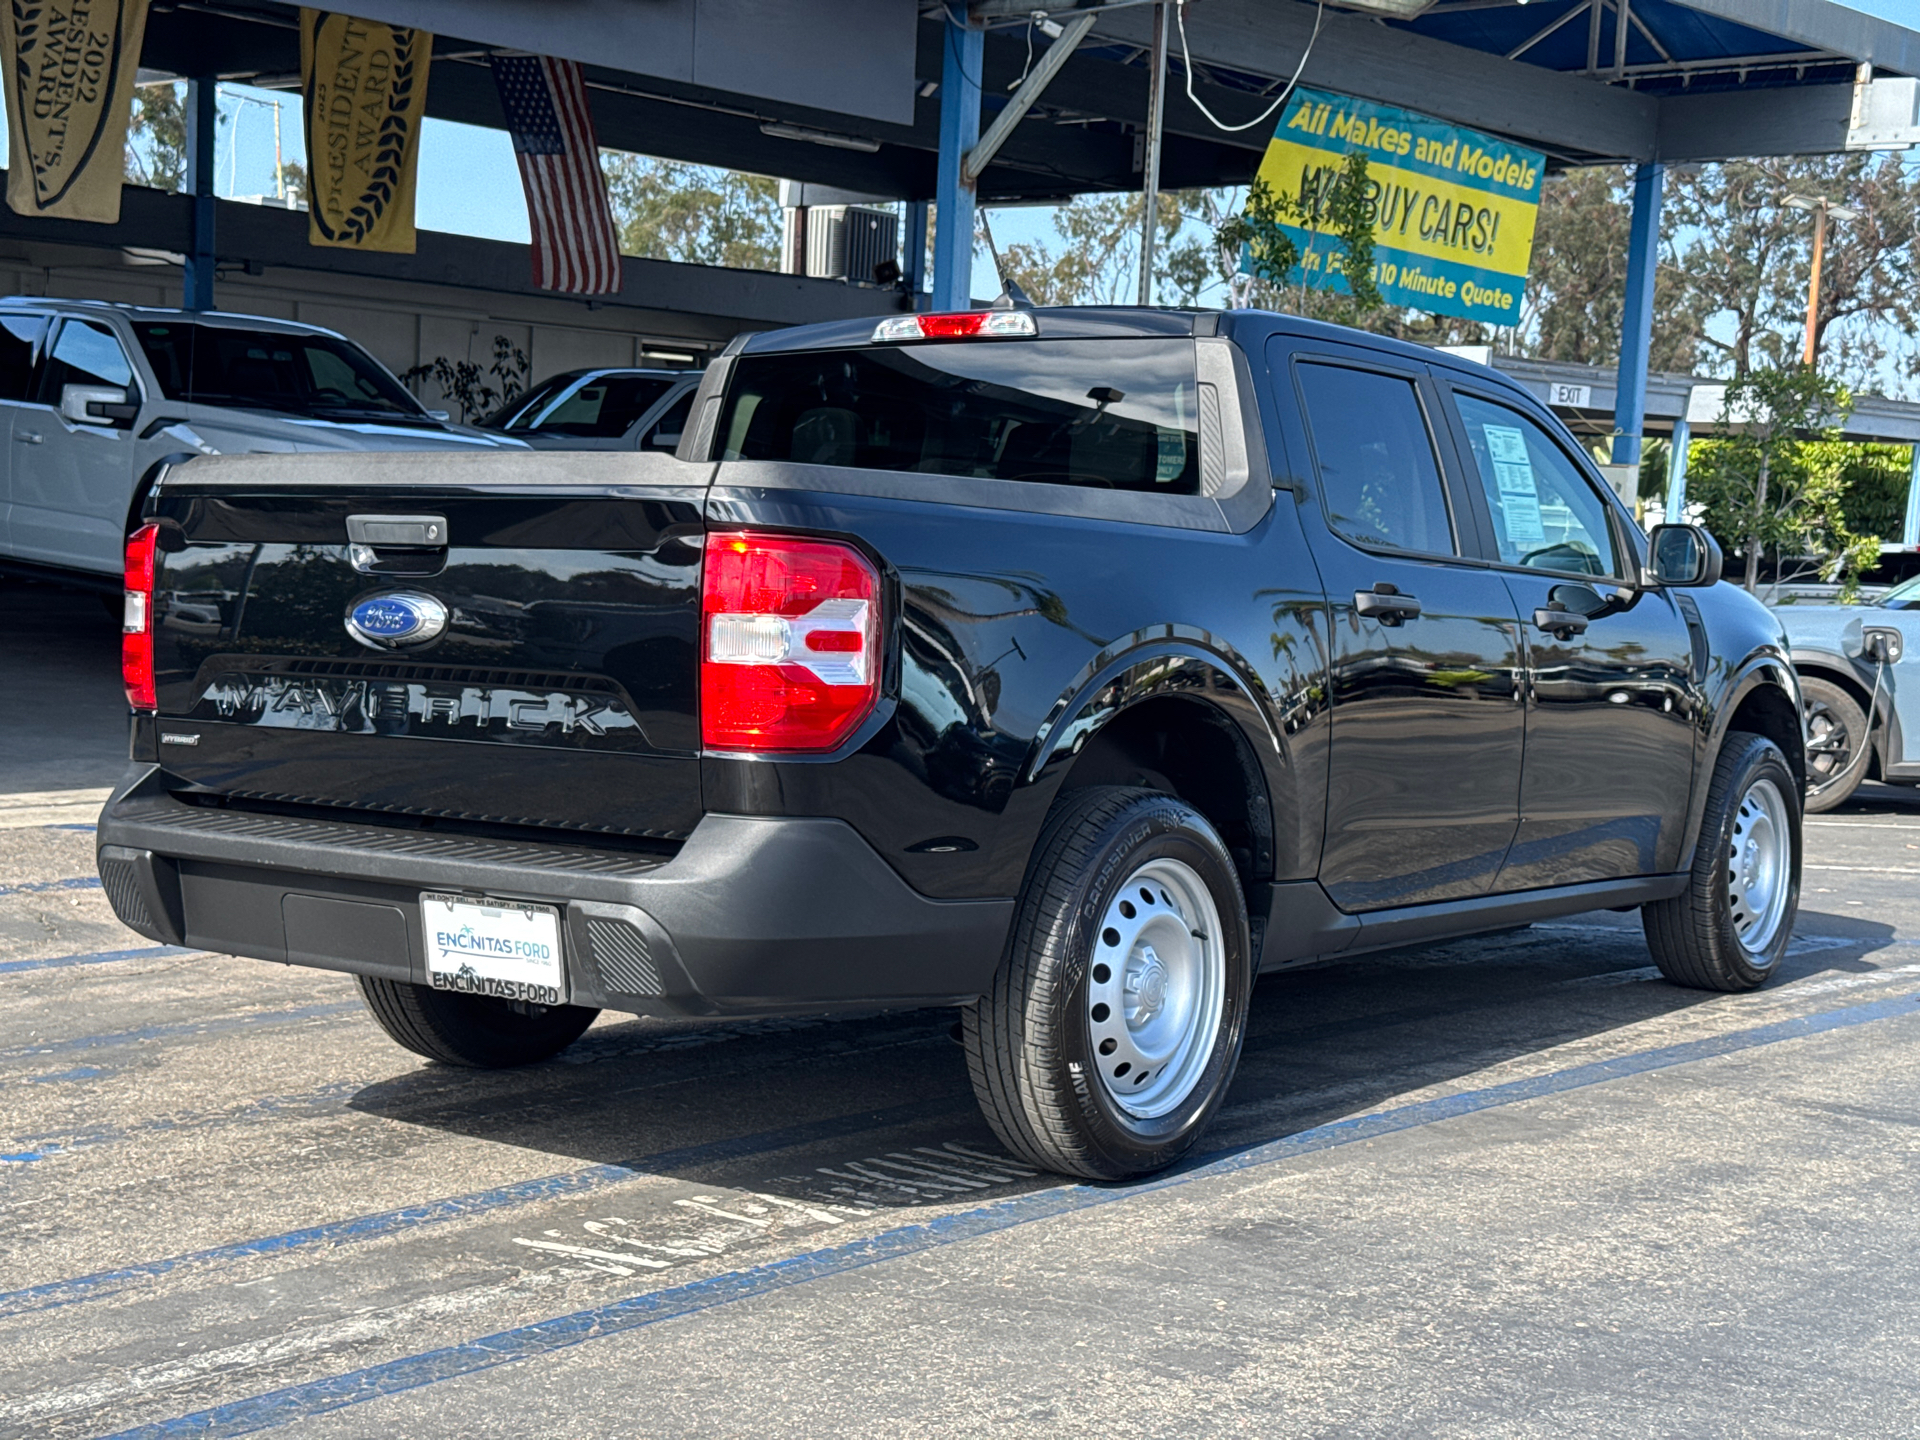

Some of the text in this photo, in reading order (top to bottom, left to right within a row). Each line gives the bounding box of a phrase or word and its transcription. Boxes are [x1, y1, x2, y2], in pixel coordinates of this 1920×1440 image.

[34, 6, 68, 120] AWARD
[76, 31, 110, 104] 2022
[353, 49, 391, 177] AWARD
[1288, 101, 1537, 190] All Makes and Models
[1359, 178, 1420, 236] BUY
[1418, 194, 1501, 256] CARS!
[1380, 262, 1398, 286] 10
[1398, 266, 1457, 299] Minute
[1460, 280, 1513, 311] Quote
[1558, 386, 1582, 404] EXIT
[364, 603, 405, 629] Ford
[216, 683, 608, 736] MAVERICK
[163, 734, 197, 744] HYBRID
[1083, 821, 1152, 919] CROSSOVER
[426, 893, 436, 901] WE
[475, 898, 485, 906] WE
[486, 899, 511, 909] SATISFY
[516, 902, 535, 912] SINCE
[535, 905, 550, 913] 1960
[436, 929, 550, 960] ENCINITAS FORD
[432, 969, 559, 1004] ENCINITAS FORD
